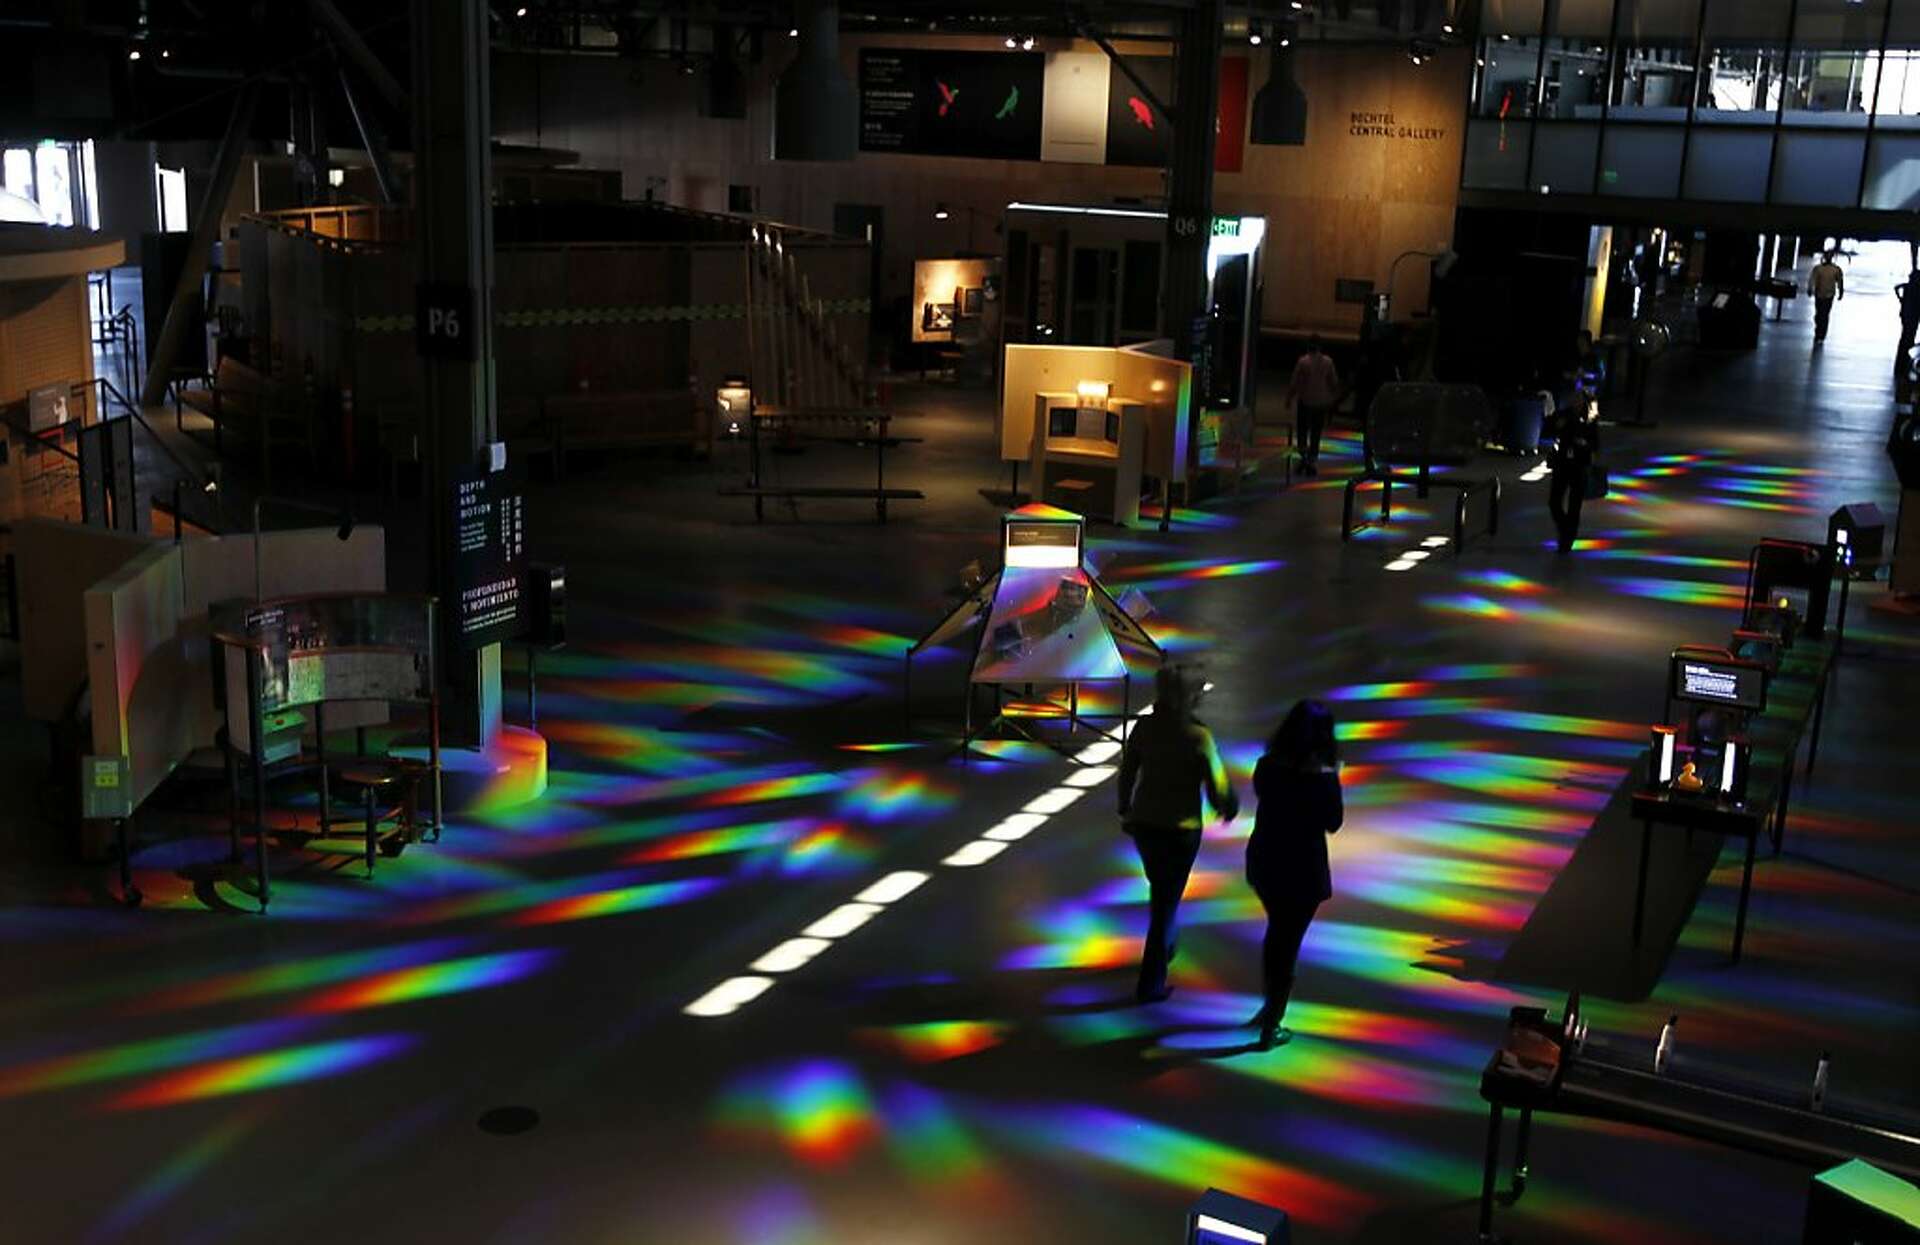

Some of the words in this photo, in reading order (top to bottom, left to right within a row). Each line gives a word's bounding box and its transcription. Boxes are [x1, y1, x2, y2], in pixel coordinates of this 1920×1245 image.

[1350, 127, 1394, 138] CENTRAL
[1398, 128, 1444, 140] GALLERY
[1175, 216, 1197, 236] Q6
[1218, 219, 1239, 236] EXIT
[428, 306, 460, 340] P6
[460, 503, 491, 519] MOTION
